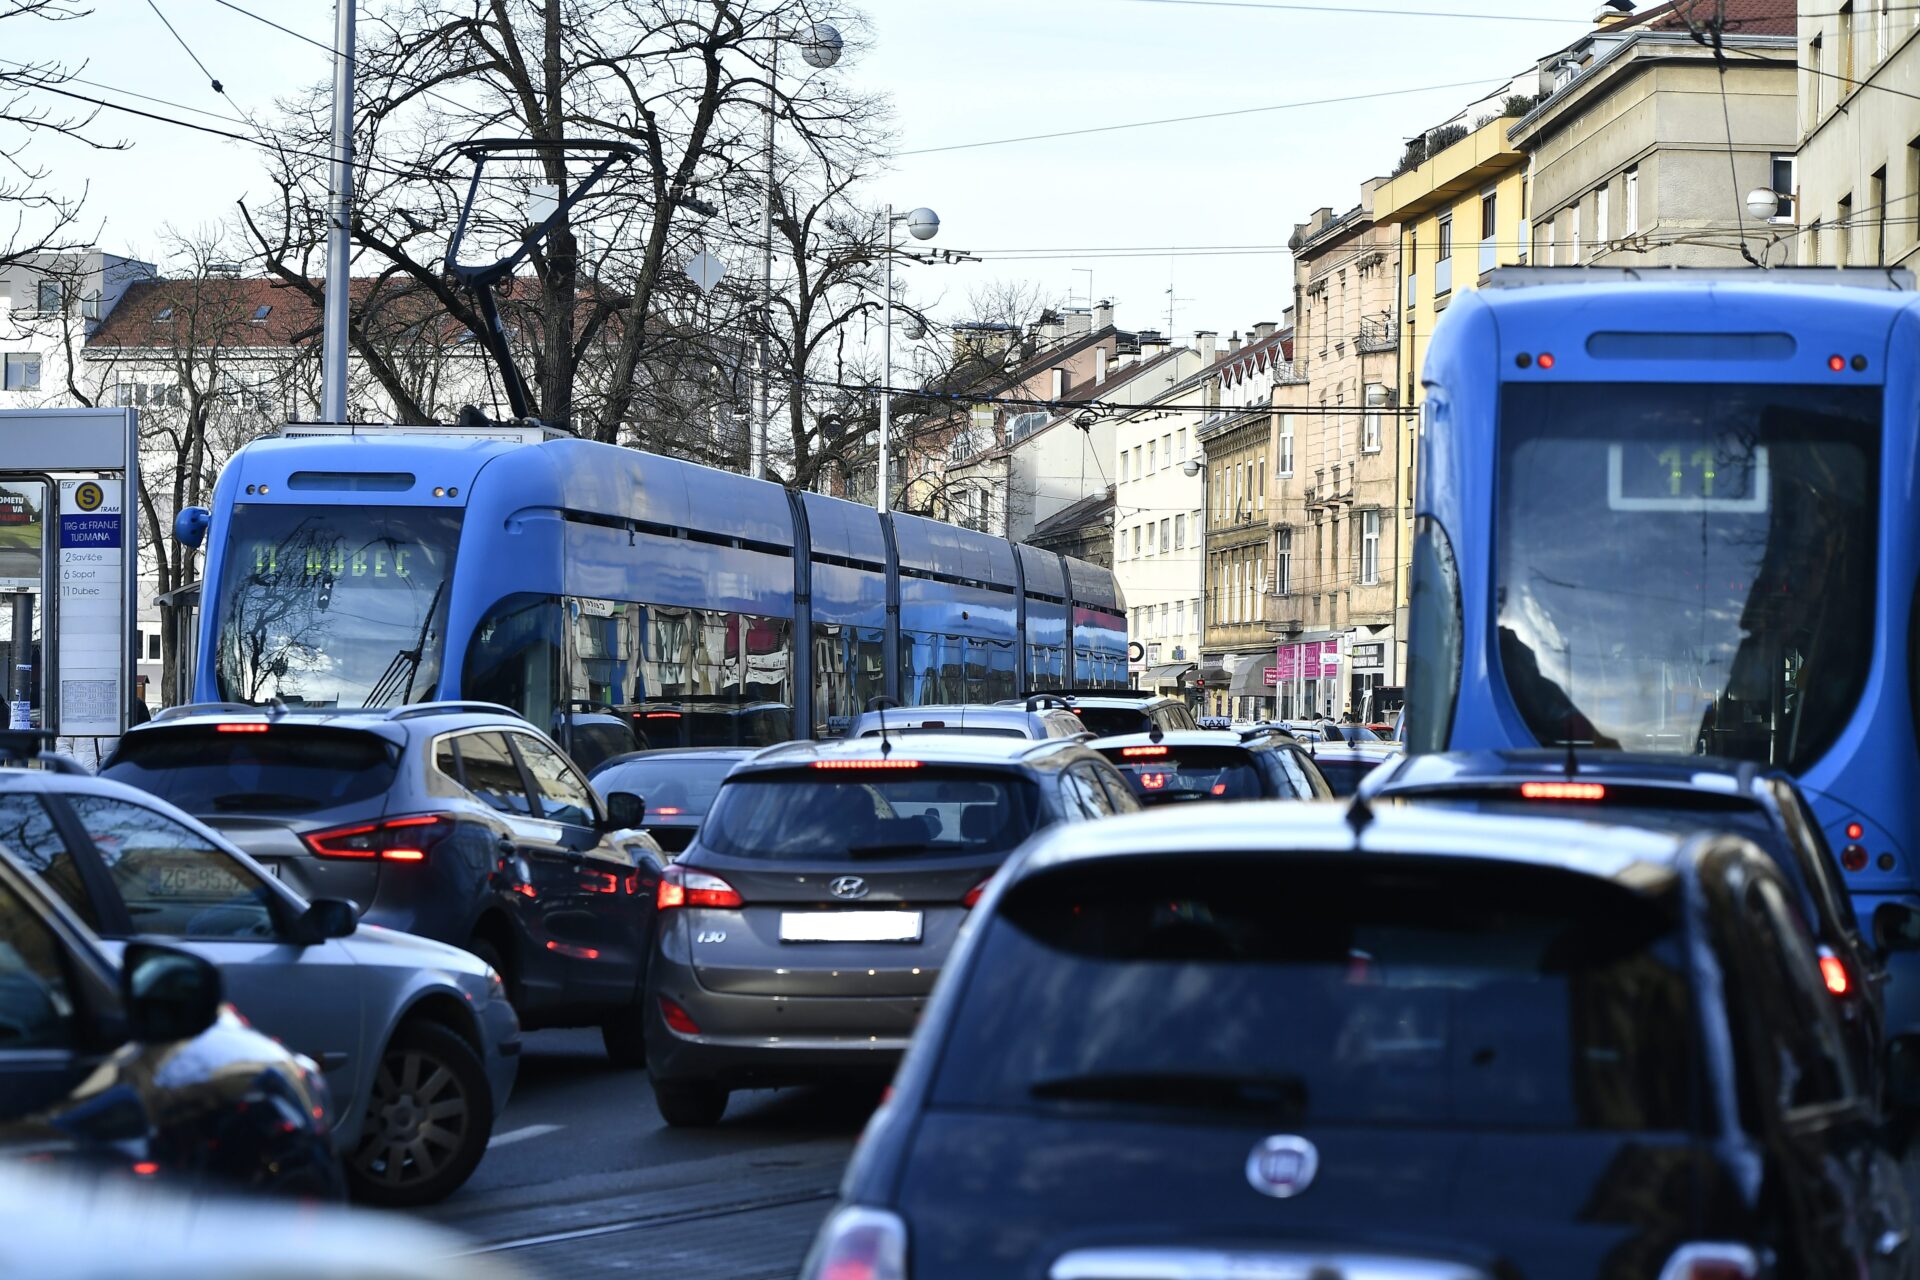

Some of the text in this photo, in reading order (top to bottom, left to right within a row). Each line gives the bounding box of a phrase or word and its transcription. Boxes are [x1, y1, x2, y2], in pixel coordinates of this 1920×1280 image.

[1658, 446, 1715, 496] 11
[83, 488, 96, 505] S
[64, 521, 78, 531] TRG
[88, 520, 119, 530] FRANJE
[65, 552, 71, 563] 2
[306, 546, 412, 578] DUBEC
[63, 569, 96, 580] 6 Sopot
[62, 586, 100, 597] 11 Dubec
[1203, 719, 1226, 727] TAXI
[163, 869, 187, 889] ZG
